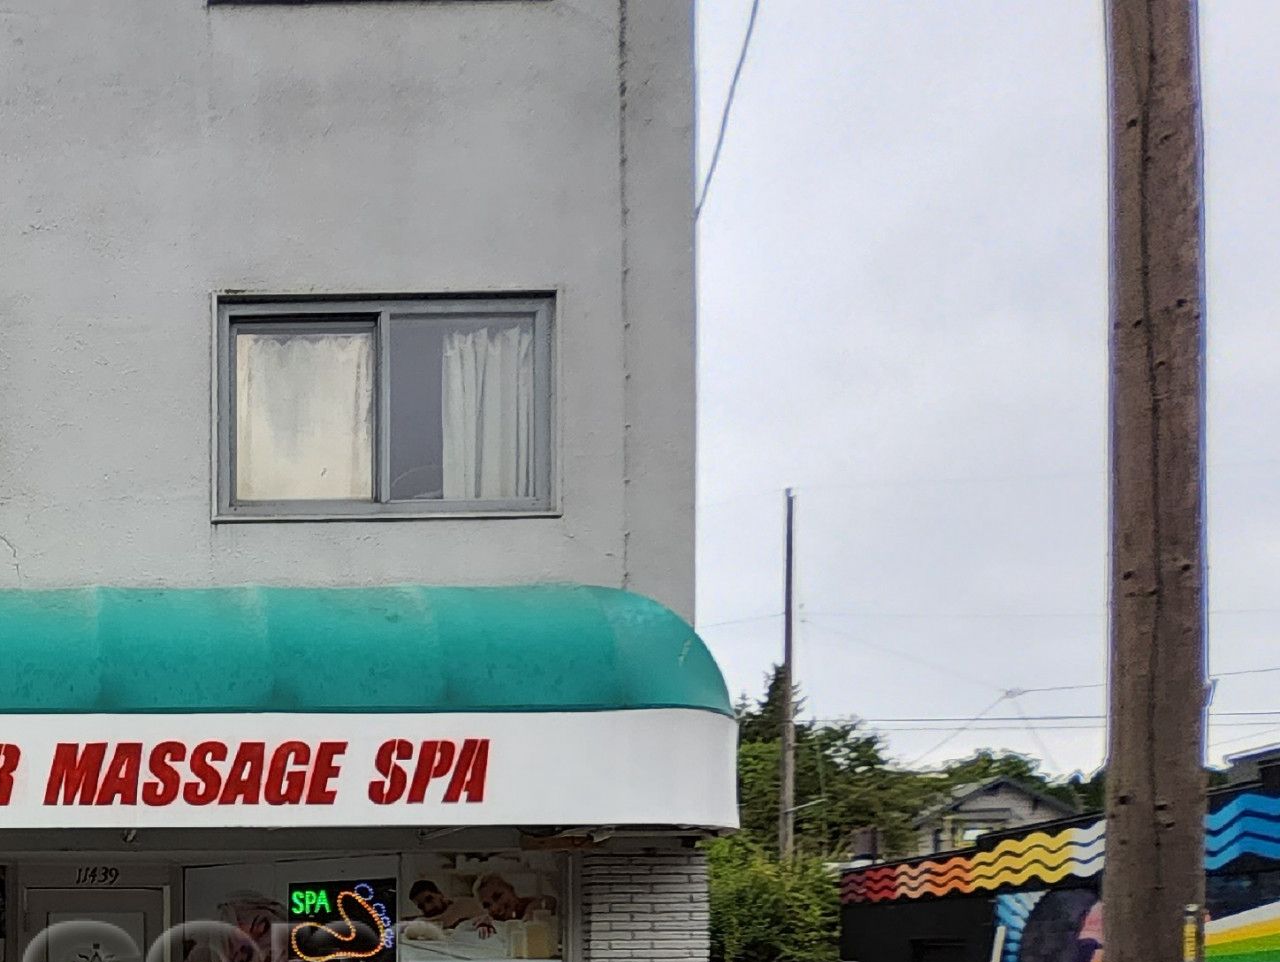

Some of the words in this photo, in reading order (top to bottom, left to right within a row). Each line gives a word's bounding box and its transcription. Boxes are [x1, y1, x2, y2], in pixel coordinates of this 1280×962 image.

[42, 741, 348, 806] MASSAGE
[368, 738, 489, 804] SPA
[76, 866, 119, 884] 11439
[291, 889, 332, 914] SPA
